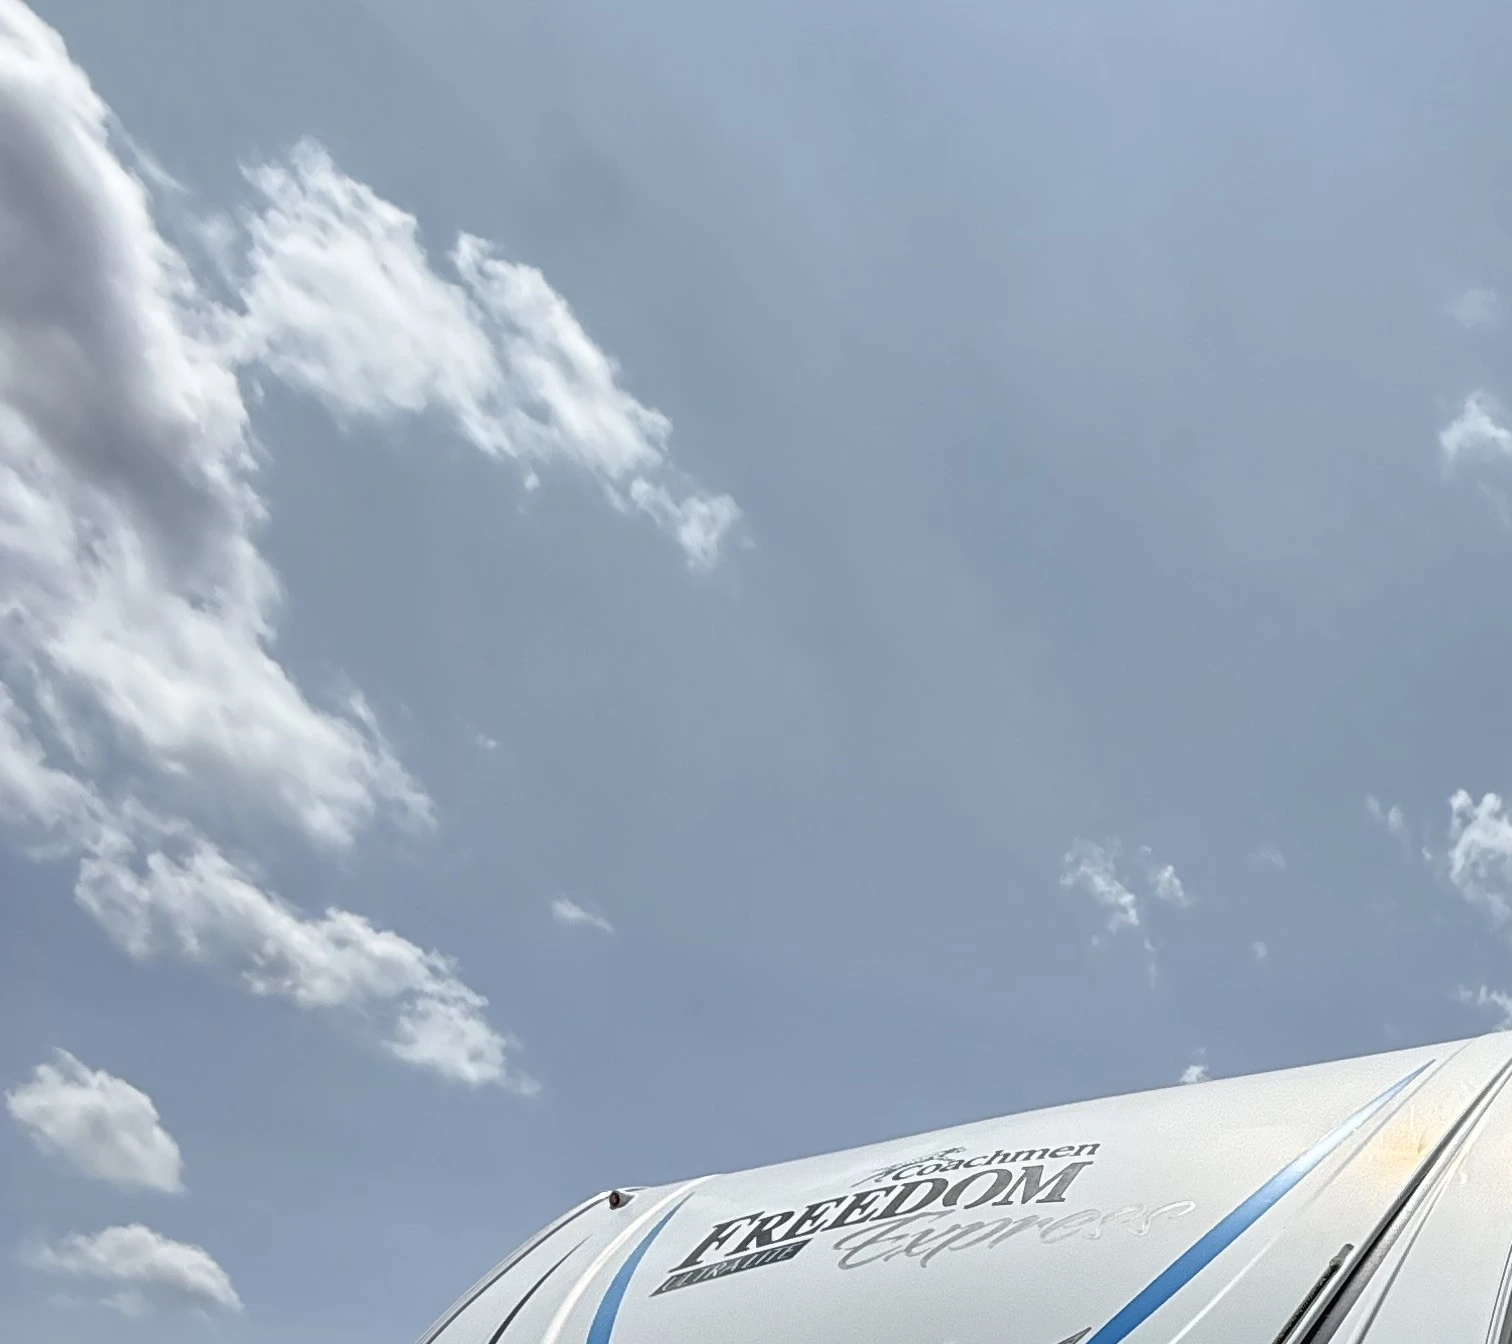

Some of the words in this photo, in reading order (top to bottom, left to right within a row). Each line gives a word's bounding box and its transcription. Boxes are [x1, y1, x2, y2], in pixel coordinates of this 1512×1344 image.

[891, 1143, 1100, 1182] Coachmen
[667, 1161, 1095, 1274] FREEDOM
[832, 1200, 1197, 1270] Express
